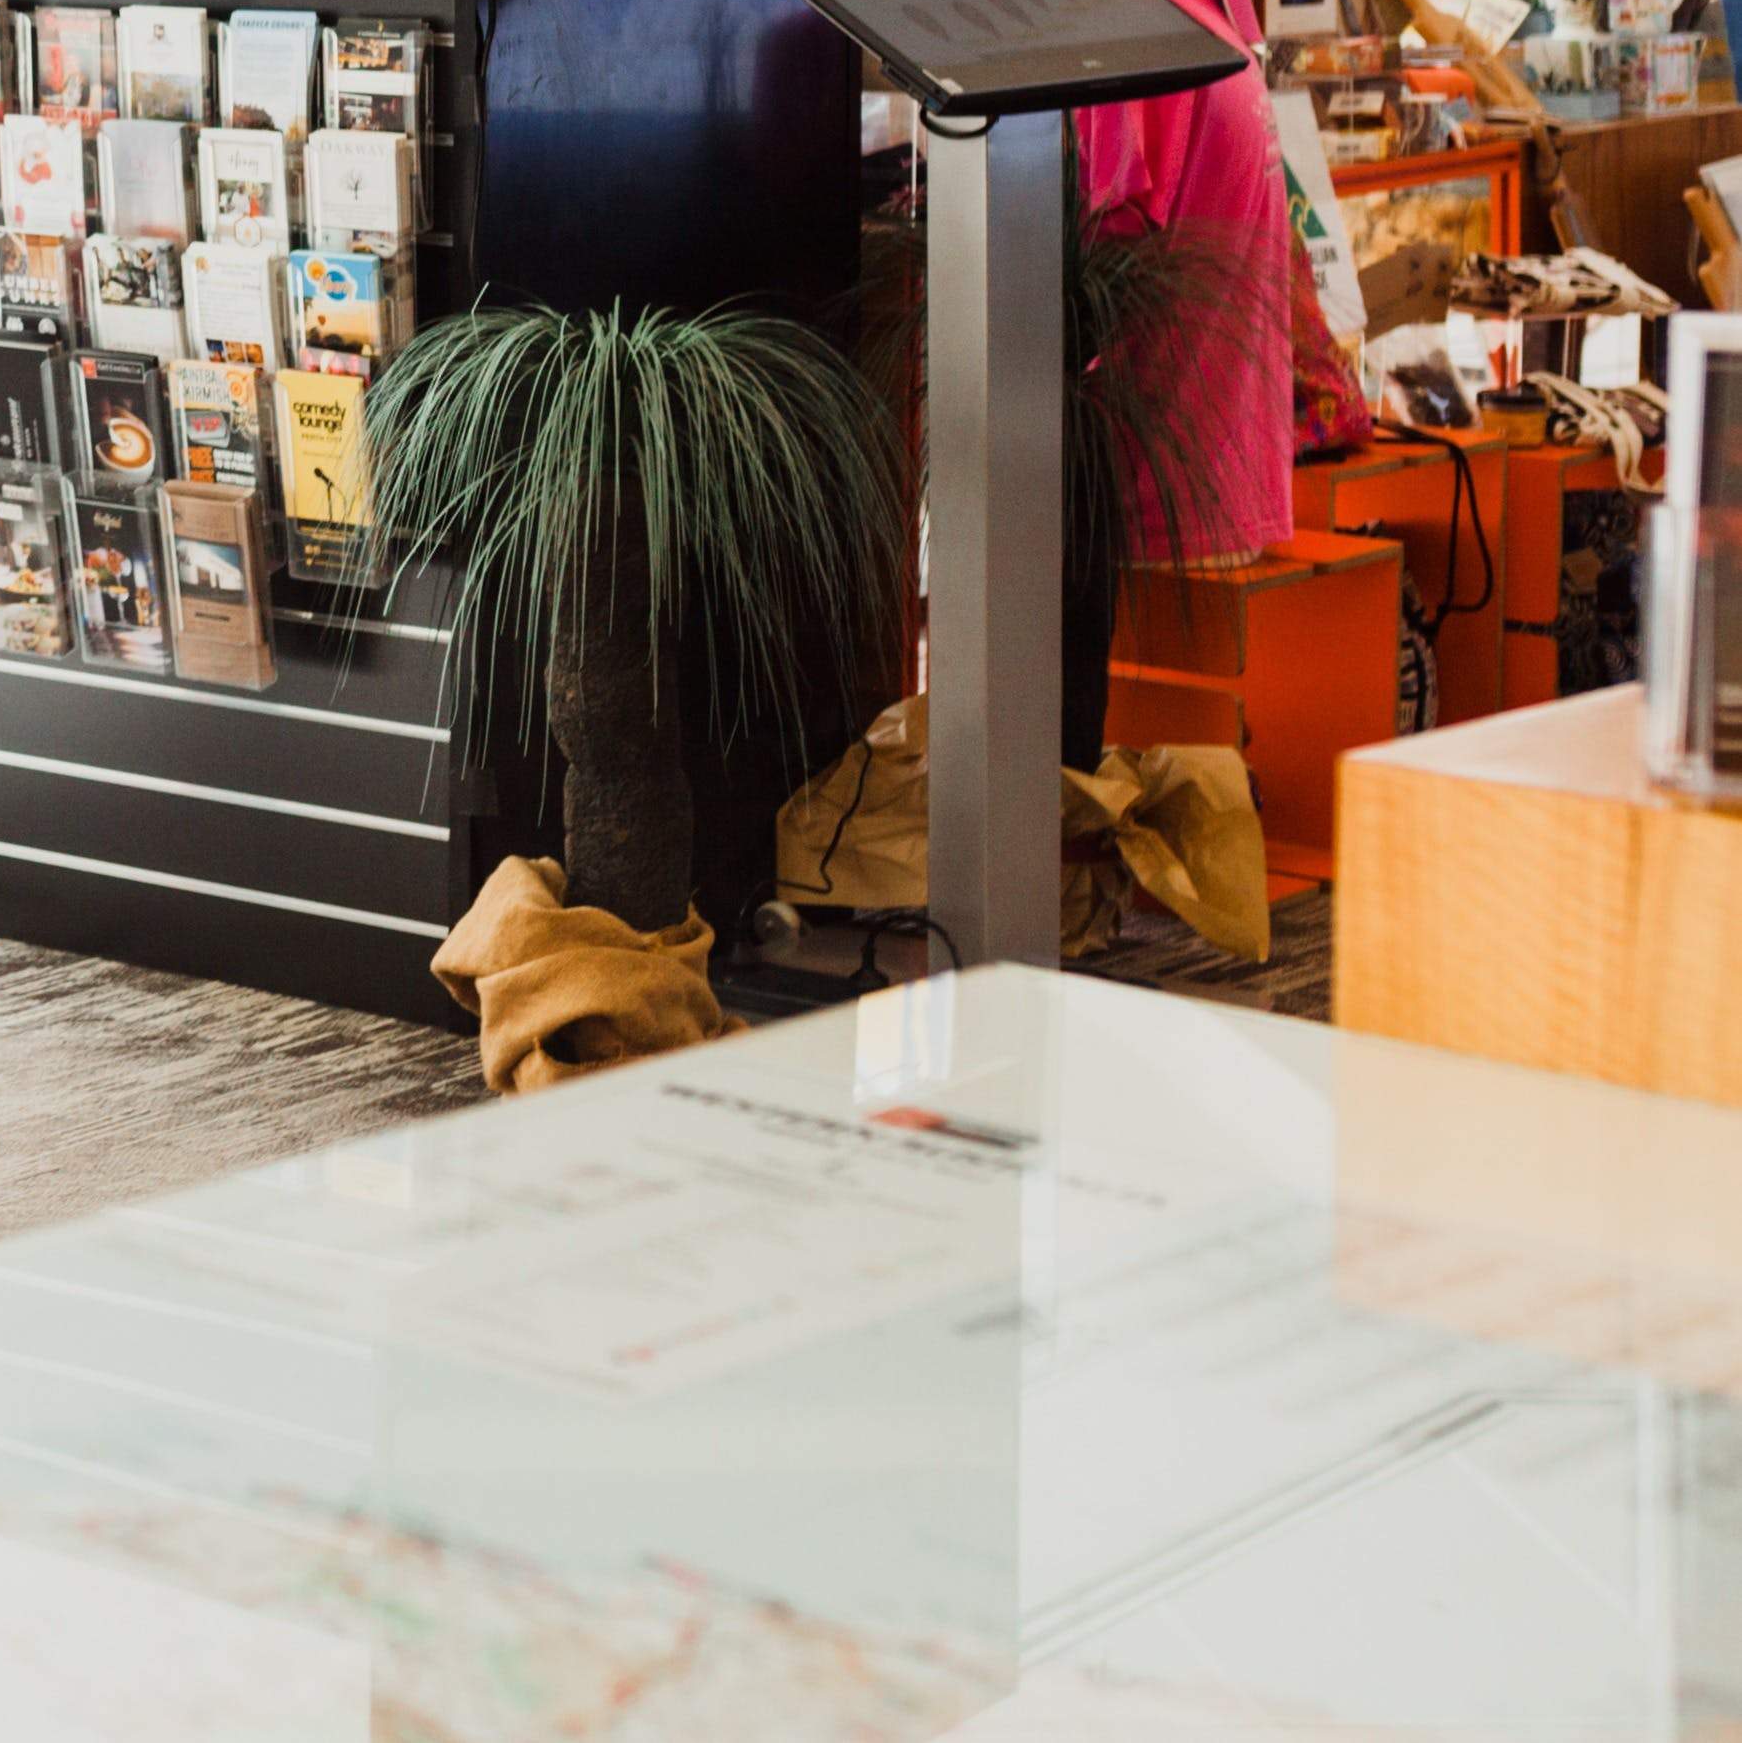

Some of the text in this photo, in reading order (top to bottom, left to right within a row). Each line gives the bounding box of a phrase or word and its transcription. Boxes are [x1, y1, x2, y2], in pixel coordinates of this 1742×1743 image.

[293, 399, 346, 421] comedy
[190, 416, 221, 432] VIP
[299, 417, 343, 433] lounge
